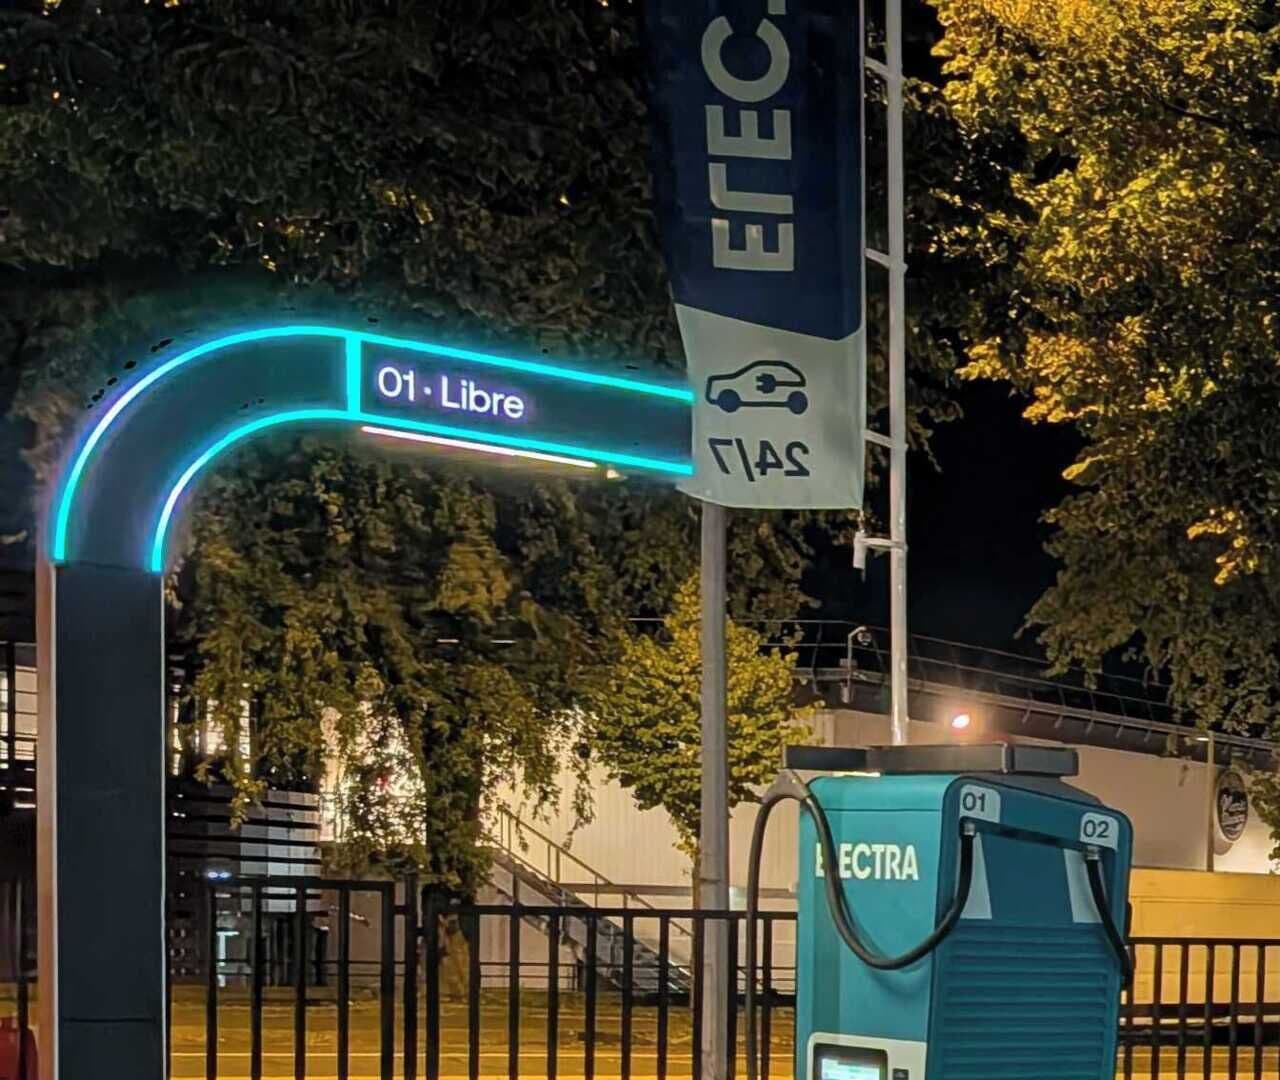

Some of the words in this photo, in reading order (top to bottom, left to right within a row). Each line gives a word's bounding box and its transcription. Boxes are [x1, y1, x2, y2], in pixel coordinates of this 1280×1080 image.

[378, 366, 415, 402] 01
[441, 375, 525, 419] Libre
[962, 791, 987, 813] 01
[1083, 819, 1109, 839] 02
[815, 842, 919, 880] EECTRA
